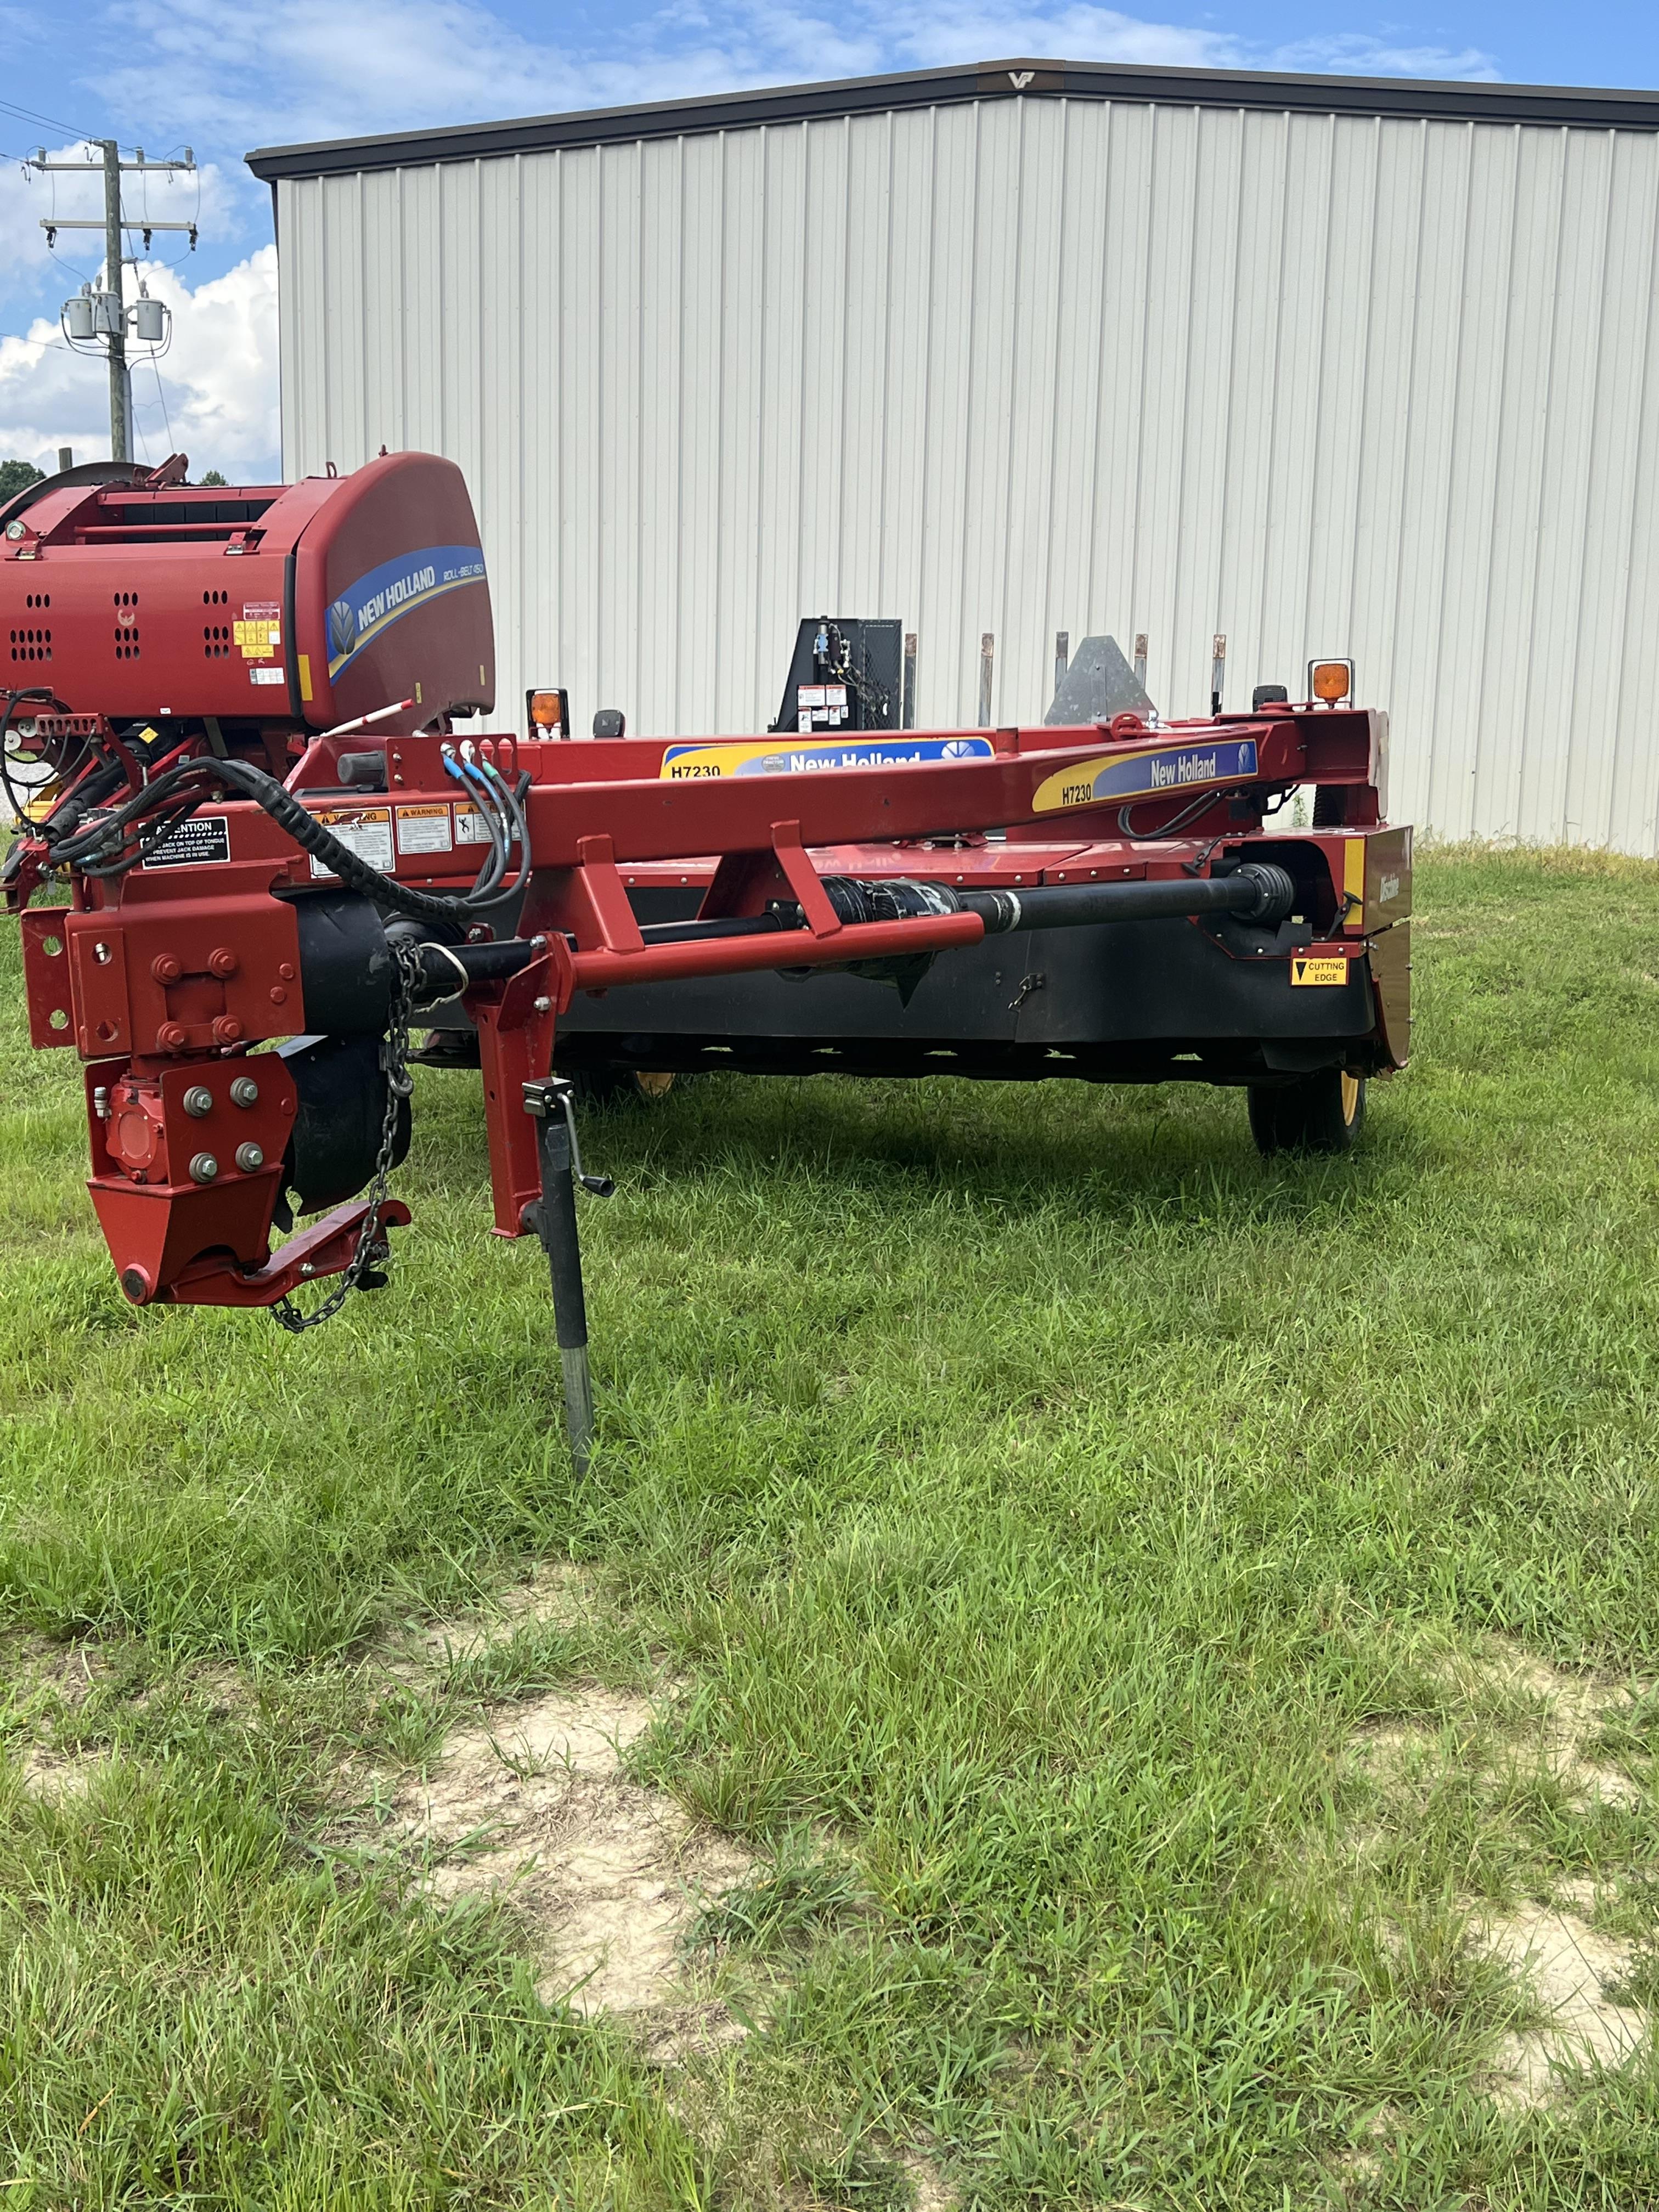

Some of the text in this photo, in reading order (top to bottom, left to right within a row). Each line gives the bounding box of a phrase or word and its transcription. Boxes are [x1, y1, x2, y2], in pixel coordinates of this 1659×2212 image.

[358, 591, 384, 631] NEW
[385, 566, 436, 610] HOLLAND
[672, 765, 720, 778] H7230
[790, 755, 836, 772] New
[1063, 752, 1216, 805] H7230 New Holland
[410, 808, 443, 816] WARNING
[156, 822, 212, 835] ANTION
[1308, 962, 1345, 970] CUTTING
